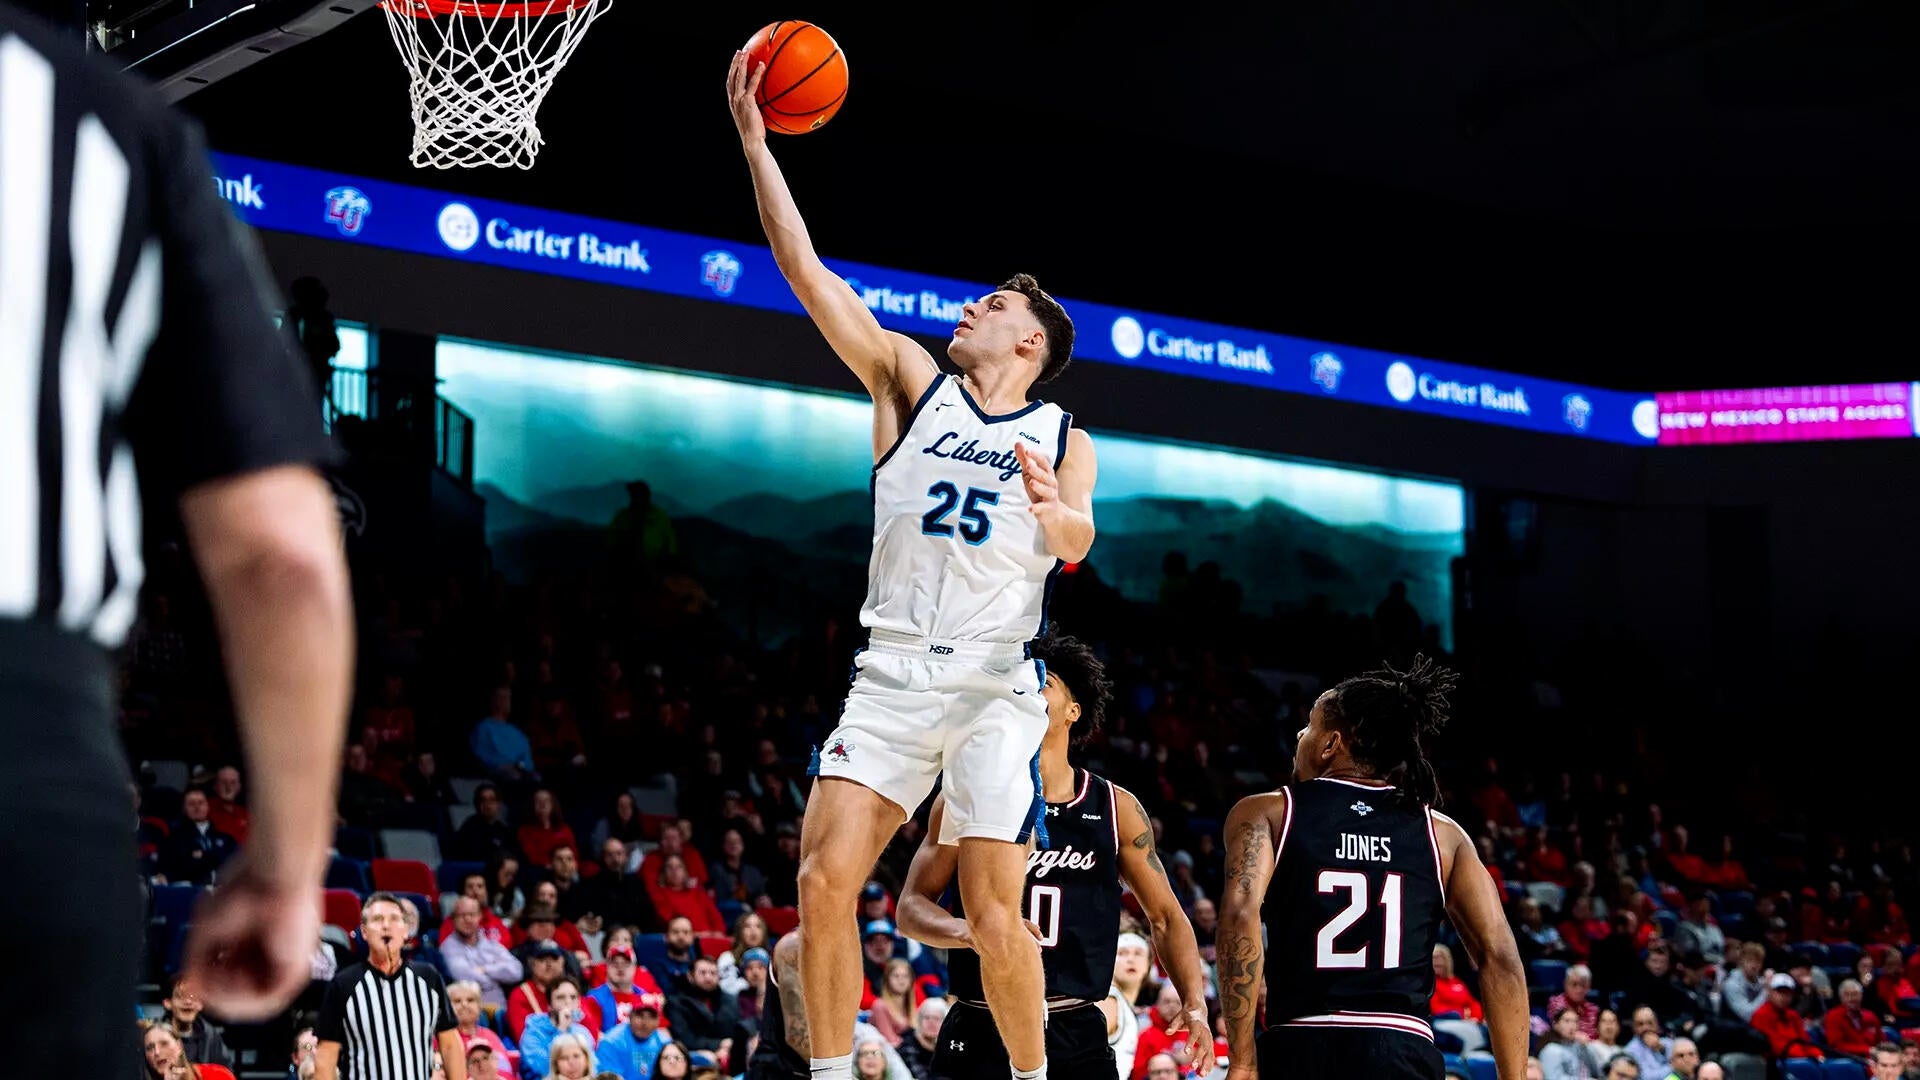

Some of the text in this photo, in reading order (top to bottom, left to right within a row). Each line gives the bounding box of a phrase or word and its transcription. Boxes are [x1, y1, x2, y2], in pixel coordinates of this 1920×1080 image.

[486, 218, 652, 274] Carter Bank
[919, 289, 975, 323] Ban
[1147, 327, 1275, 376] Carter Bank
[1419, 372, 1479, 404] Carter
[1480, 381, 1531, 416] Bank
[1660, 404, 1906, 430] NEW MEXICO STATE AGGIES
[922, 431, 1023, 482] Liberty
[921, 480, 1000, 547] 25
[929, 644, 954, 656] HSTP
[1025, 844, 1096, 879] ggies
[1335, 833, 1392, 862] JONES
[1315, 868, 1404, 969] 21
